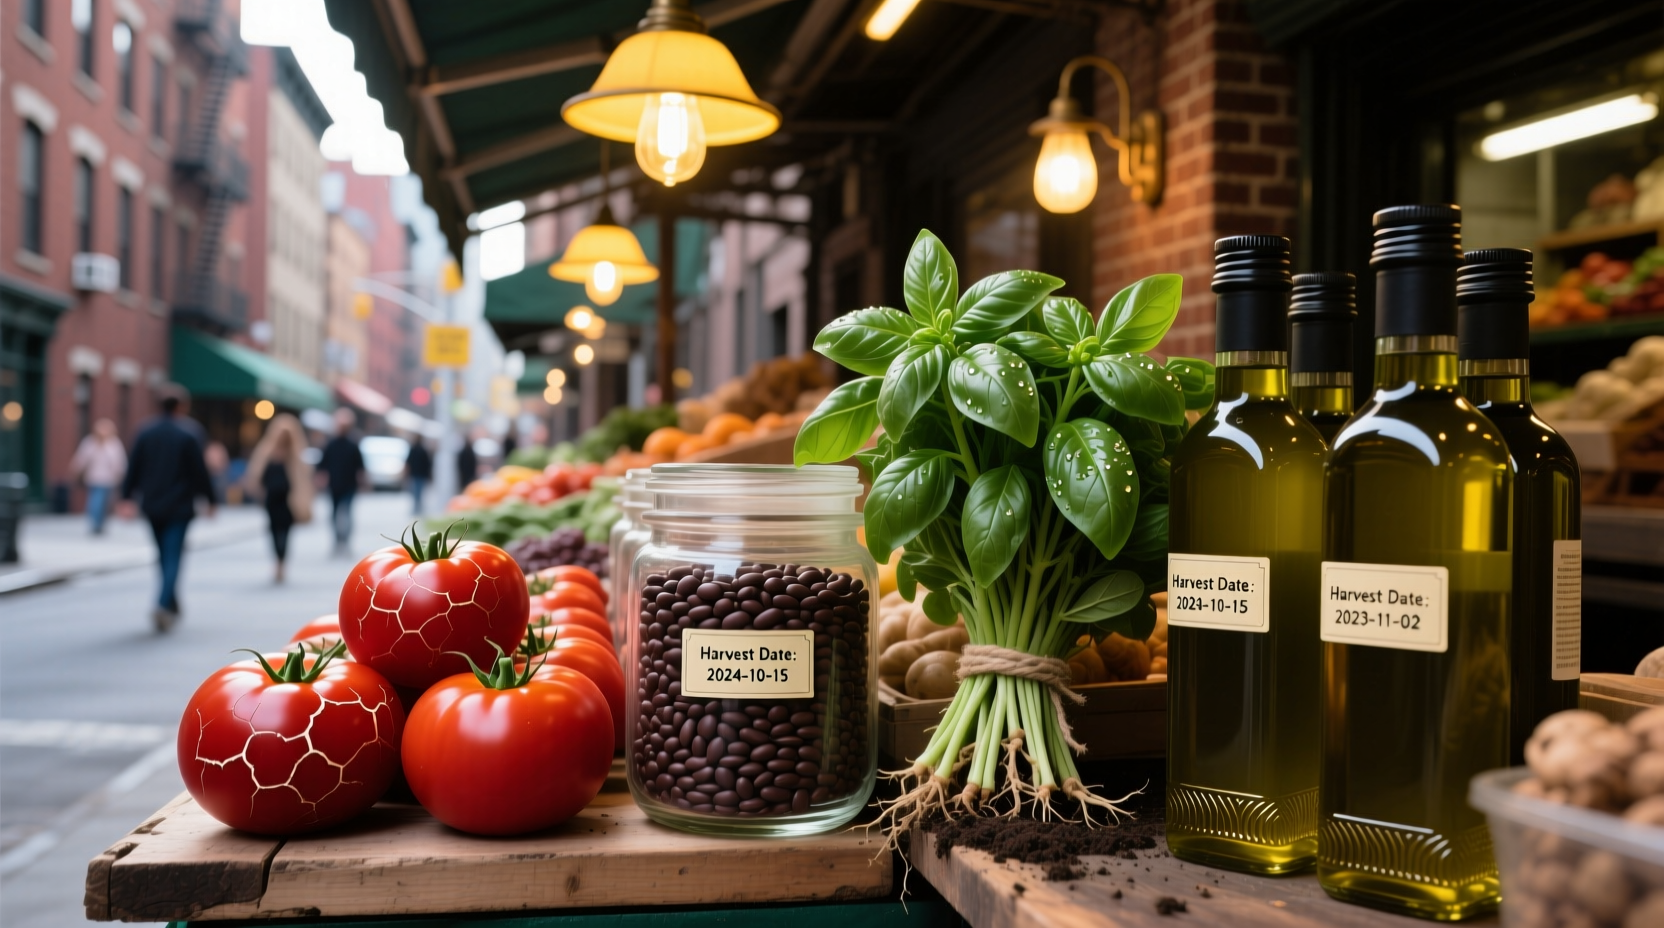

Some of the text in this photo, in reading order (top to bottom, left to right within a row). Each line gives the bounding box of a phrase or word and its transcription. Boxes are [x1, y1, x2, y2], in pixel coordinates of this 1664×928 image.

[1172, 573, 1255, 593] Harvest Date:
[1330, 585, 1430, 608] Harvest Date:
[1335, 609, 1421, 630] 2023-11-02
[700, 646, 797, 662] Harvest Date:
[706, 667, 789, 682] 2024-10-15
